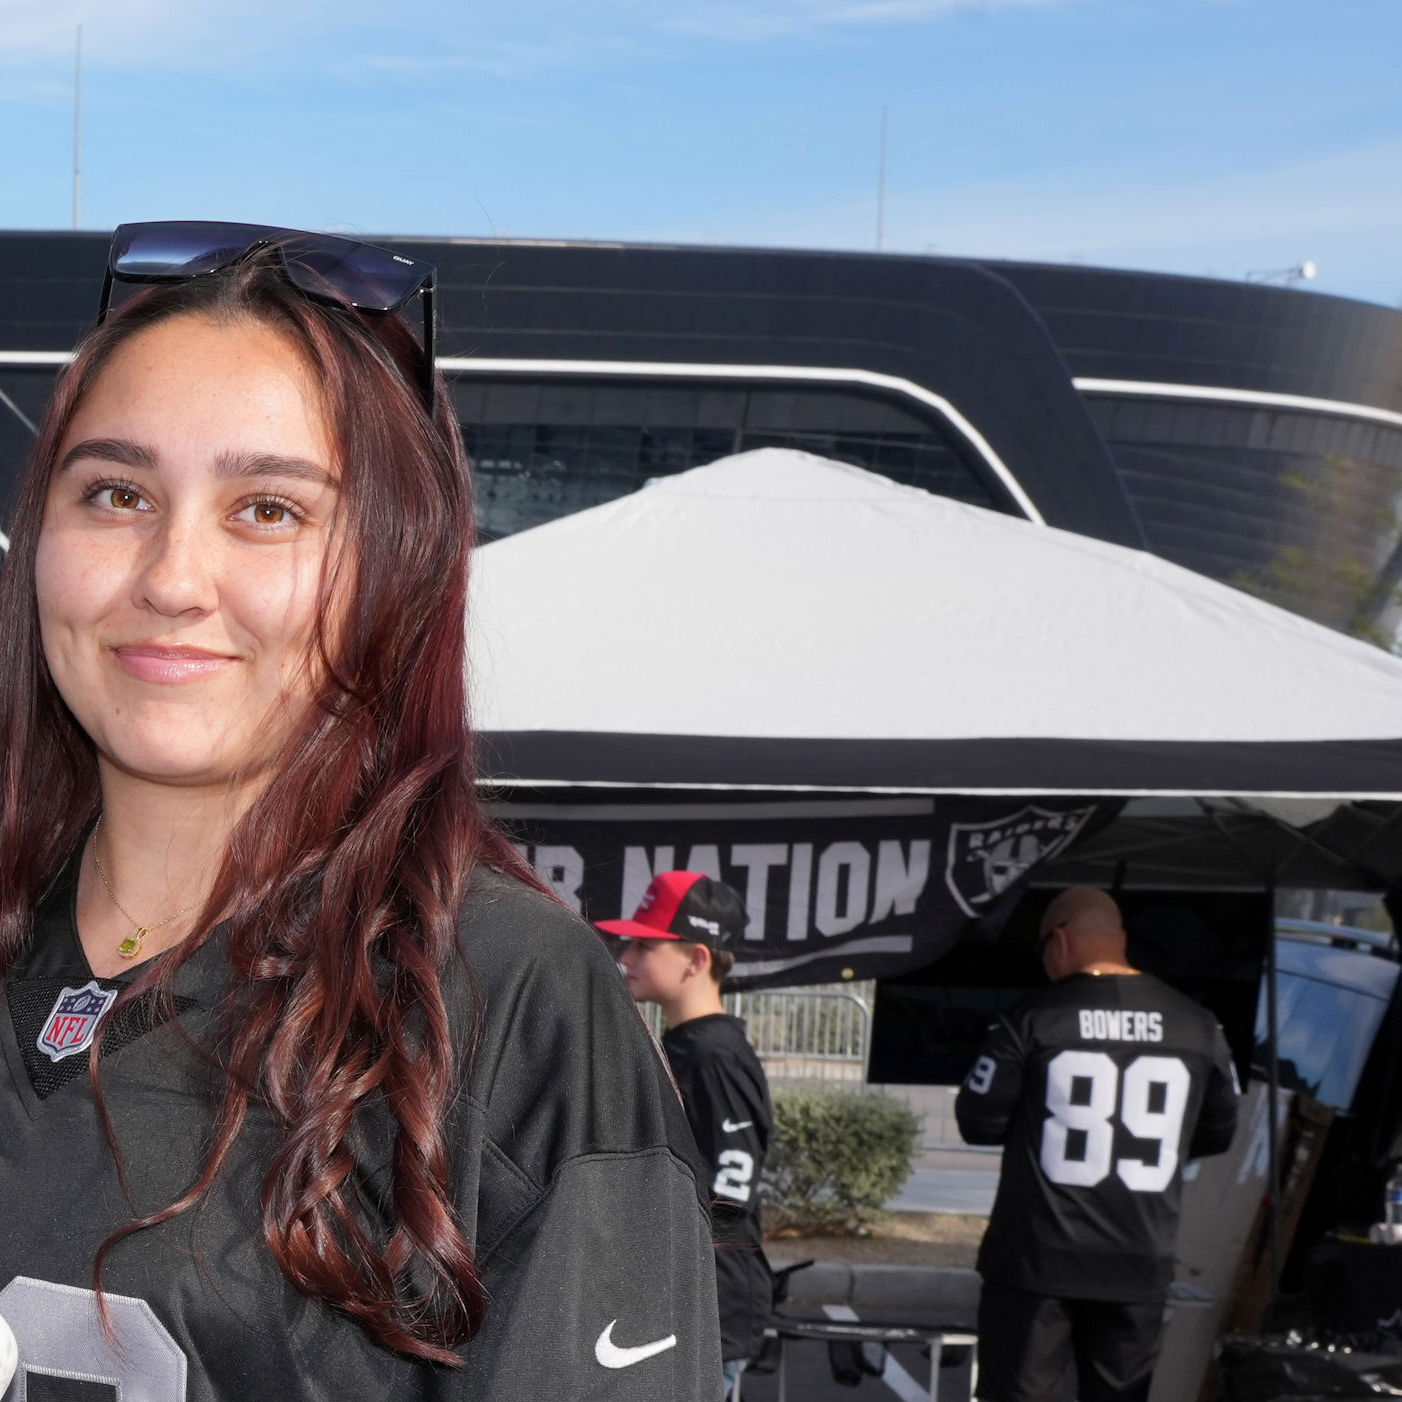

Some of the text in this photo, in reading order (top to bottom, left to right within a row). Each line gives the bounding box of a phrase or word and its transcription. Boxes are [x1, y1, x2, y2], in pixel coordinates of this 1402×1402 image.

[45, 1016, 89, 1047] NFL
[1078, 1008, 1164, 1043] BOWERS
[1039, 1049, 1192, 1193] 89
[713, 1148, 755, 1202] 2
